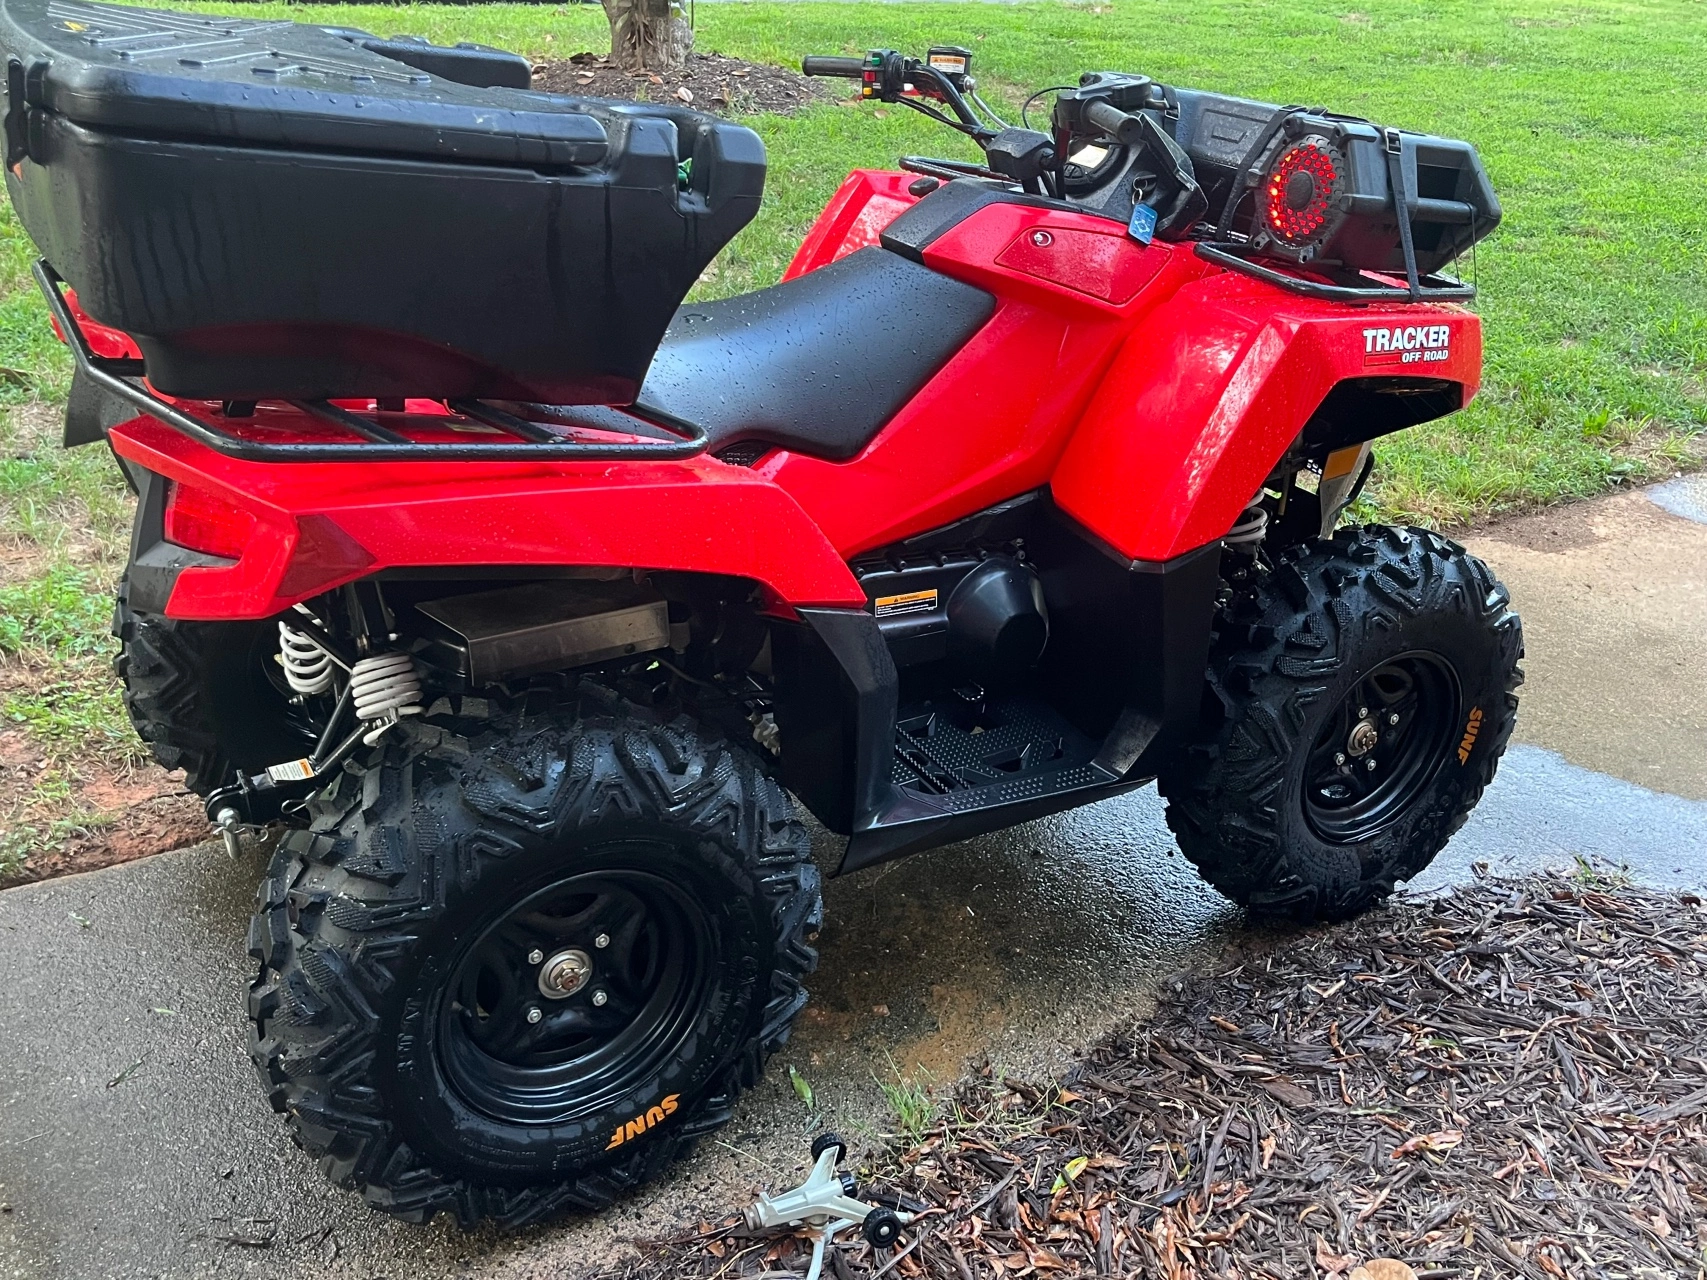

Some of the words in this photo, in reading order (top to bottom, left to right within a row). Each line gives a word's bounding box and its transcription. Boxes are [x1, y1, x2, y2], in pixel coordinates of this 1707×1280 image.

[1363, 325, 1450, 352] TRACKER
[1401, 352, 1422, 363] OFF
[1423, 350, 1449, 362] ROAD
[1457, 705, 1483, 767] SUNF
[604, 1093, 681, 1151] SUNF
